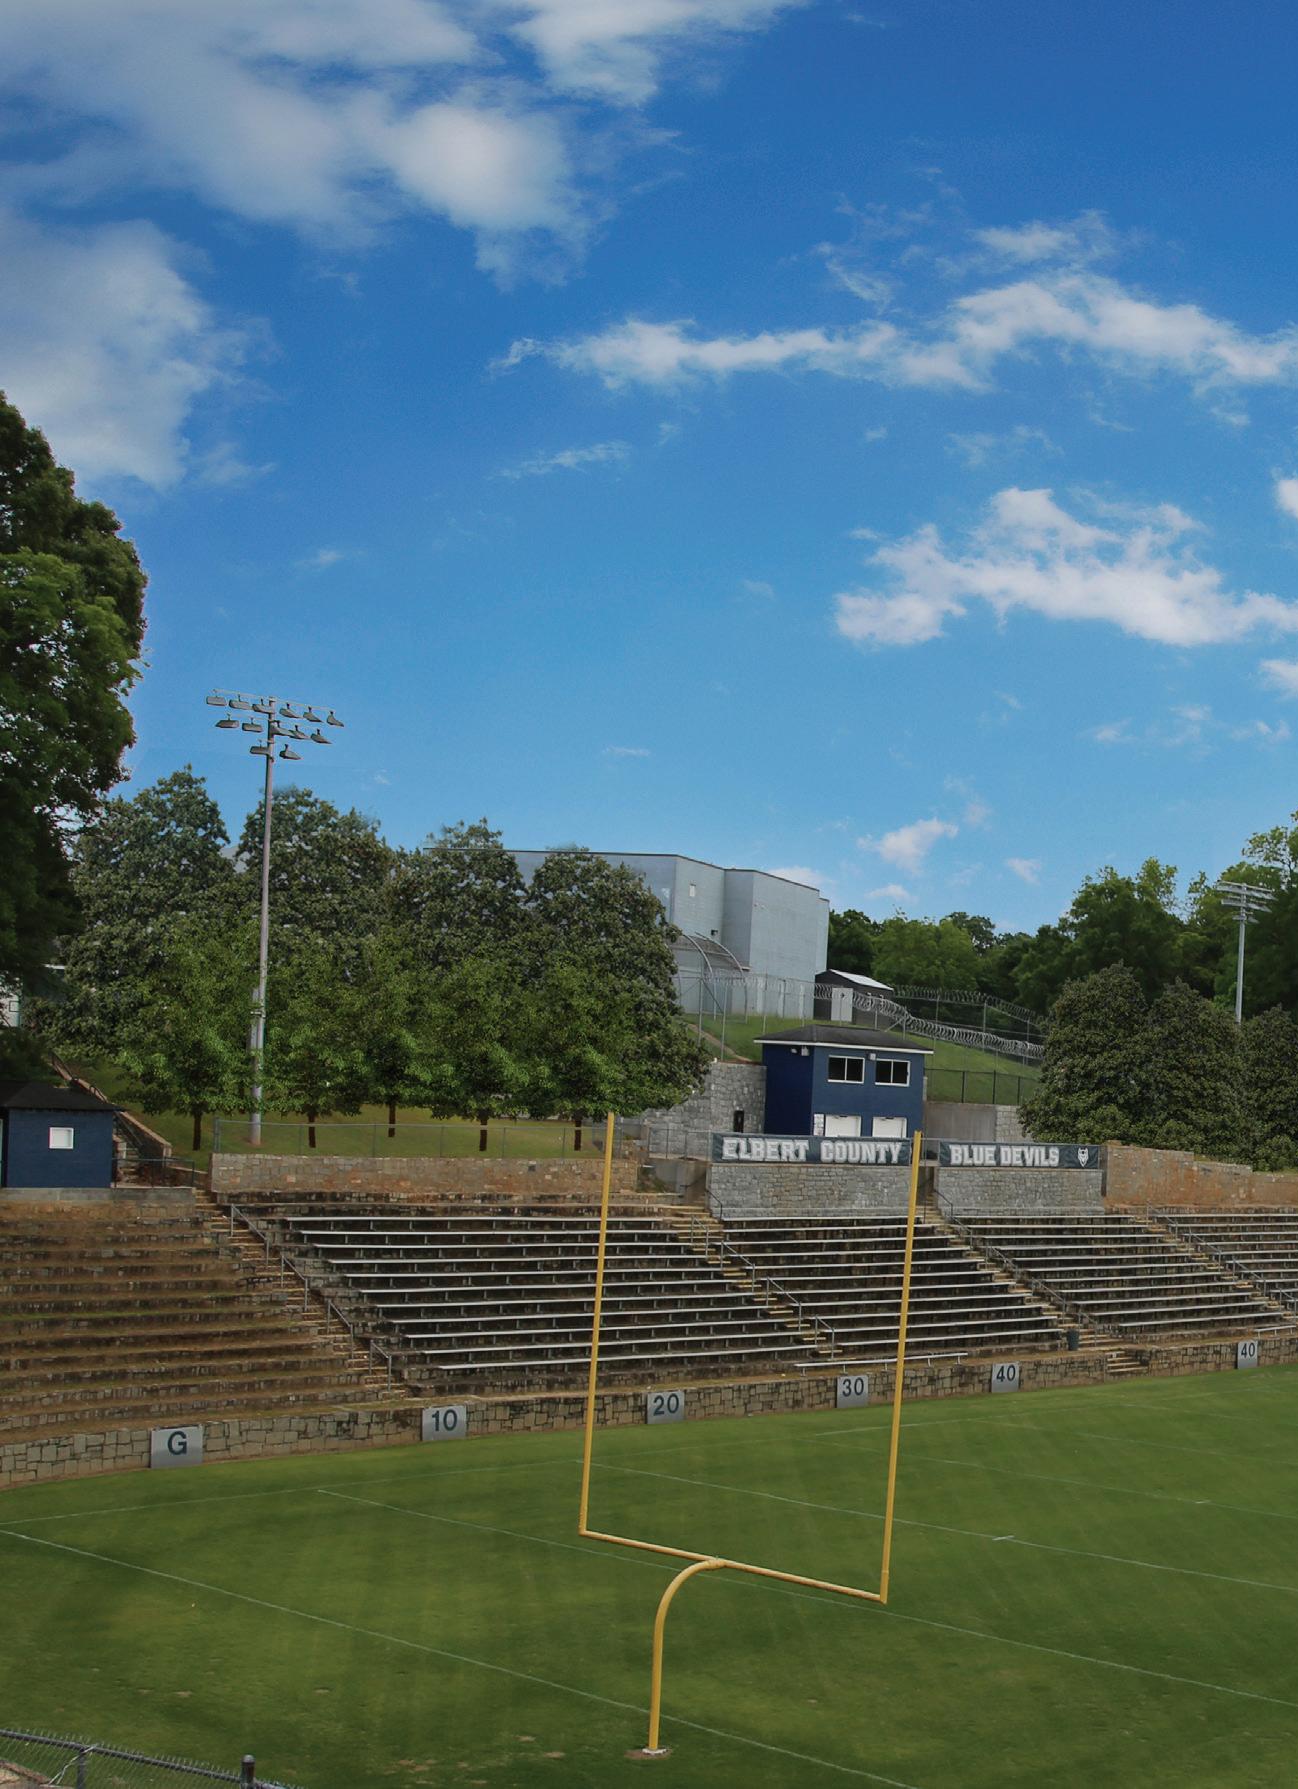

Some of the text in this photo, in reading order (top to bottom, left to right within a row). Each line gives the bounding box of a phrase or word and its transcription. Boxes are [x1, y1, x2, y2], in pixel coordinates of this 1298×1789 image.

[722, 1137, 902, 1164] ELBERT COUNTY
[949, 1144, 1060, 1167] BLUE DEVILS
[1240, 1342, 1256, 1358] 40
[996, 1364, 1016, 1383] 40
[841, 1377, 864, 1398] 30
[653, 1393, 680, 1418] 20
[431, 1408, 458, 1432] 10
[167, 1430, 188, 1456] G
